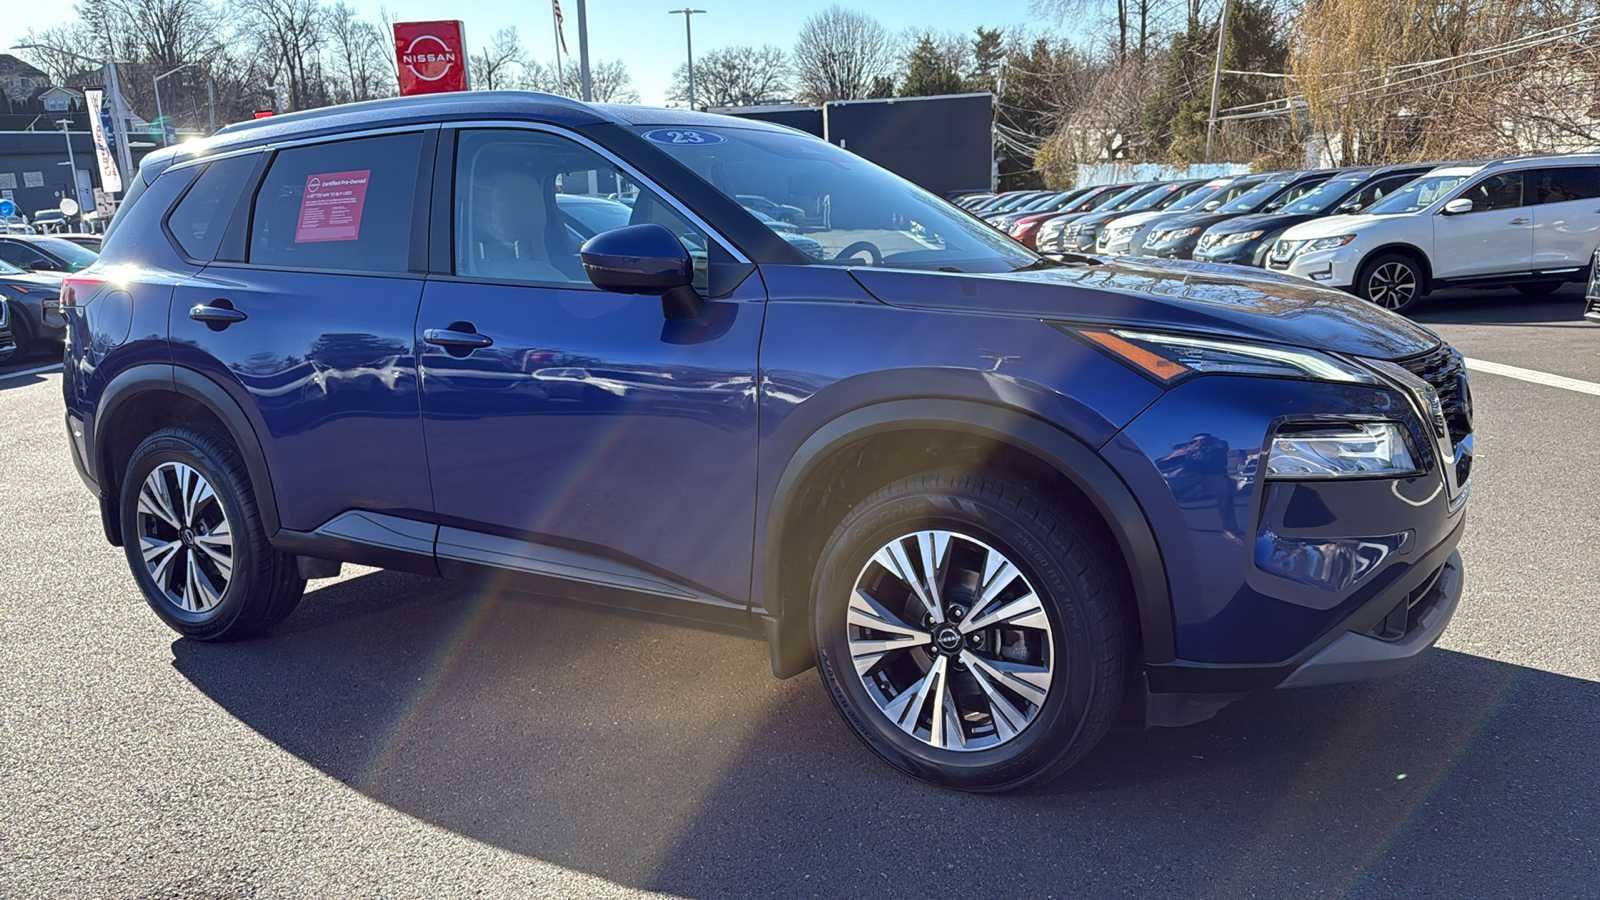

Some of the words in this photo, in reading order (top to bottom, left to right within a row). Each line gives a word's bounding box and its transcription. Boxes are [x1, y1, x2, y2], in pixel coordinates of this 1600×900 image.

[402, 53, 455, 63] NISSAN
[667, 131, 705, 143] 23
[1013, 532, 1049, 567] 235/60
